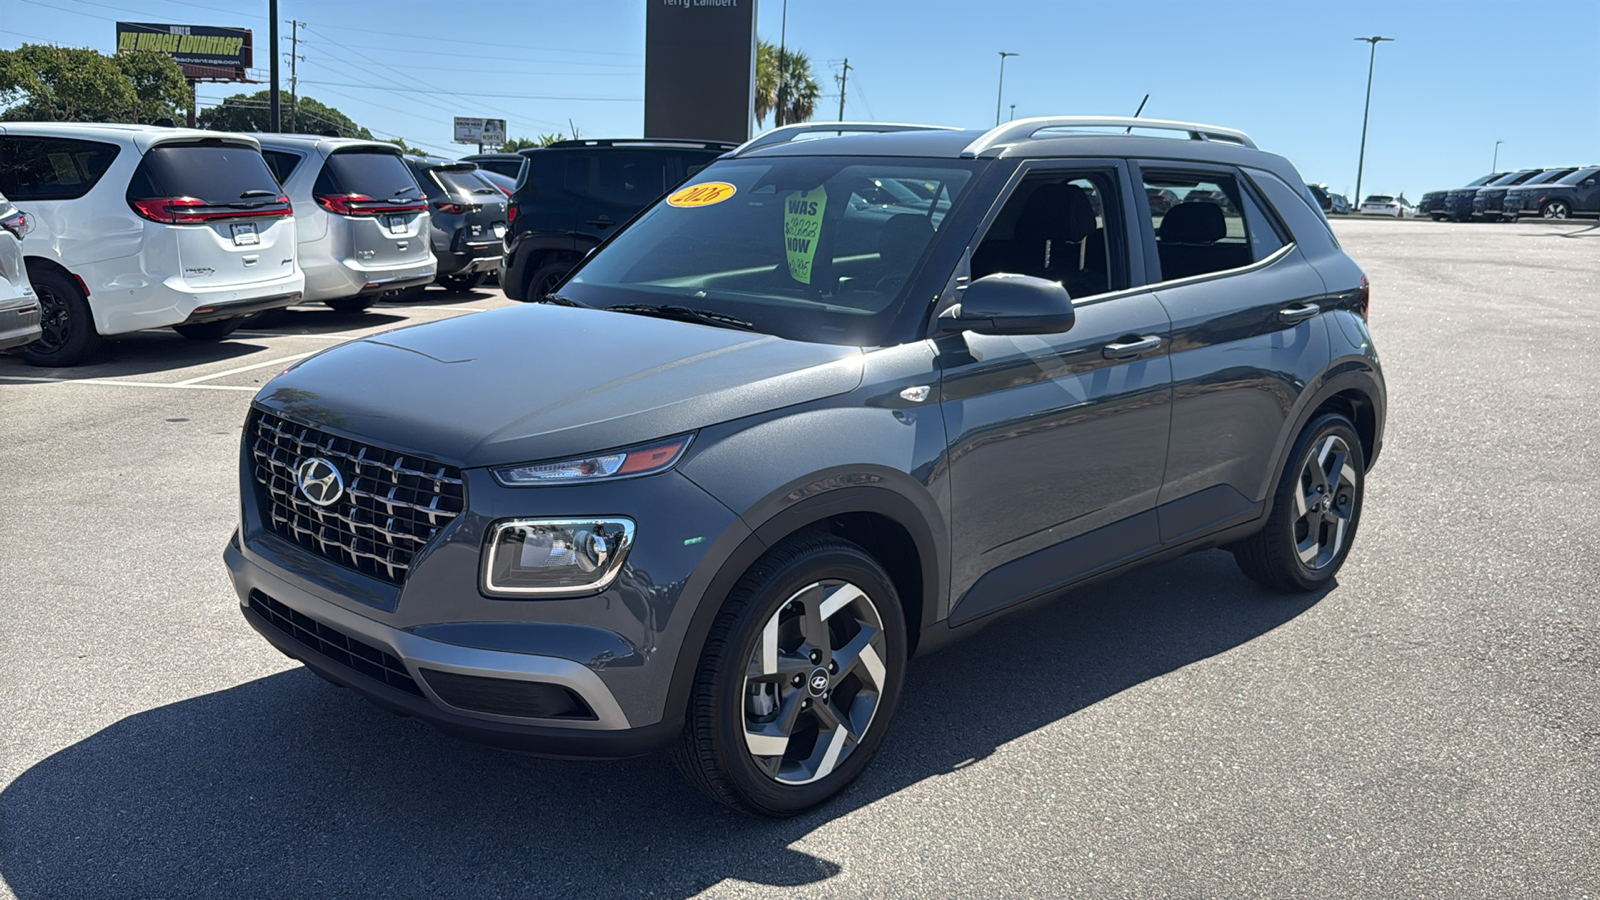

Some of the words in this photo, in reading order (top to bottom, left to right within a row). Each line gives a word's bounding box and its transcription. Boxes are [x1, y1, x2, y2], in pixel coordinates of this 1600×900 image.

[663, 0, 690, 8] Terry
[169, 25, 185, 35] WHAT
[185, 26, 191, 35] IS
[118, 31, 138, 50] THE
[136, 32, 180, 52] MIRACLE
[178, 34, 243, 56] ADVANTAGE?
[173, 56, 241, 65] eadvantage.com
[672, 186, 731, 202] 2026
[788, 200, 819, 216] WAS
[786, 237, 811, 254] NOW
